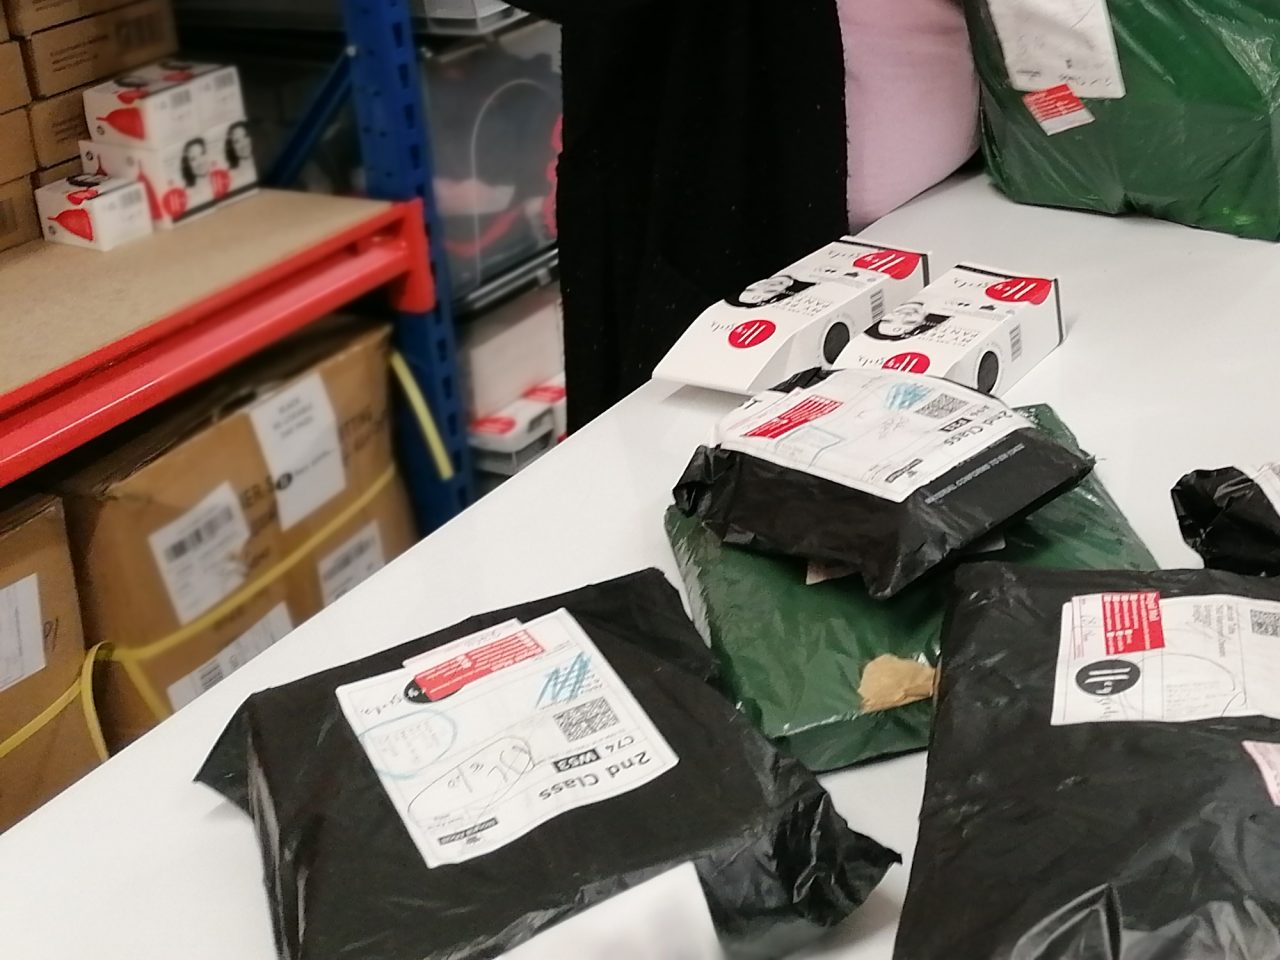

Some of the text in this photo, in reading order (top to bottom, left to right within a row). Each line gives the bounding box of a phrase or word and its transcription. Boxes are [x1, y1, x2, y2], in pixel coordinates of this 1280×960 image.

[605, 735, 634, 753] C74
[538, 751, 651, 801] 2nd Class
